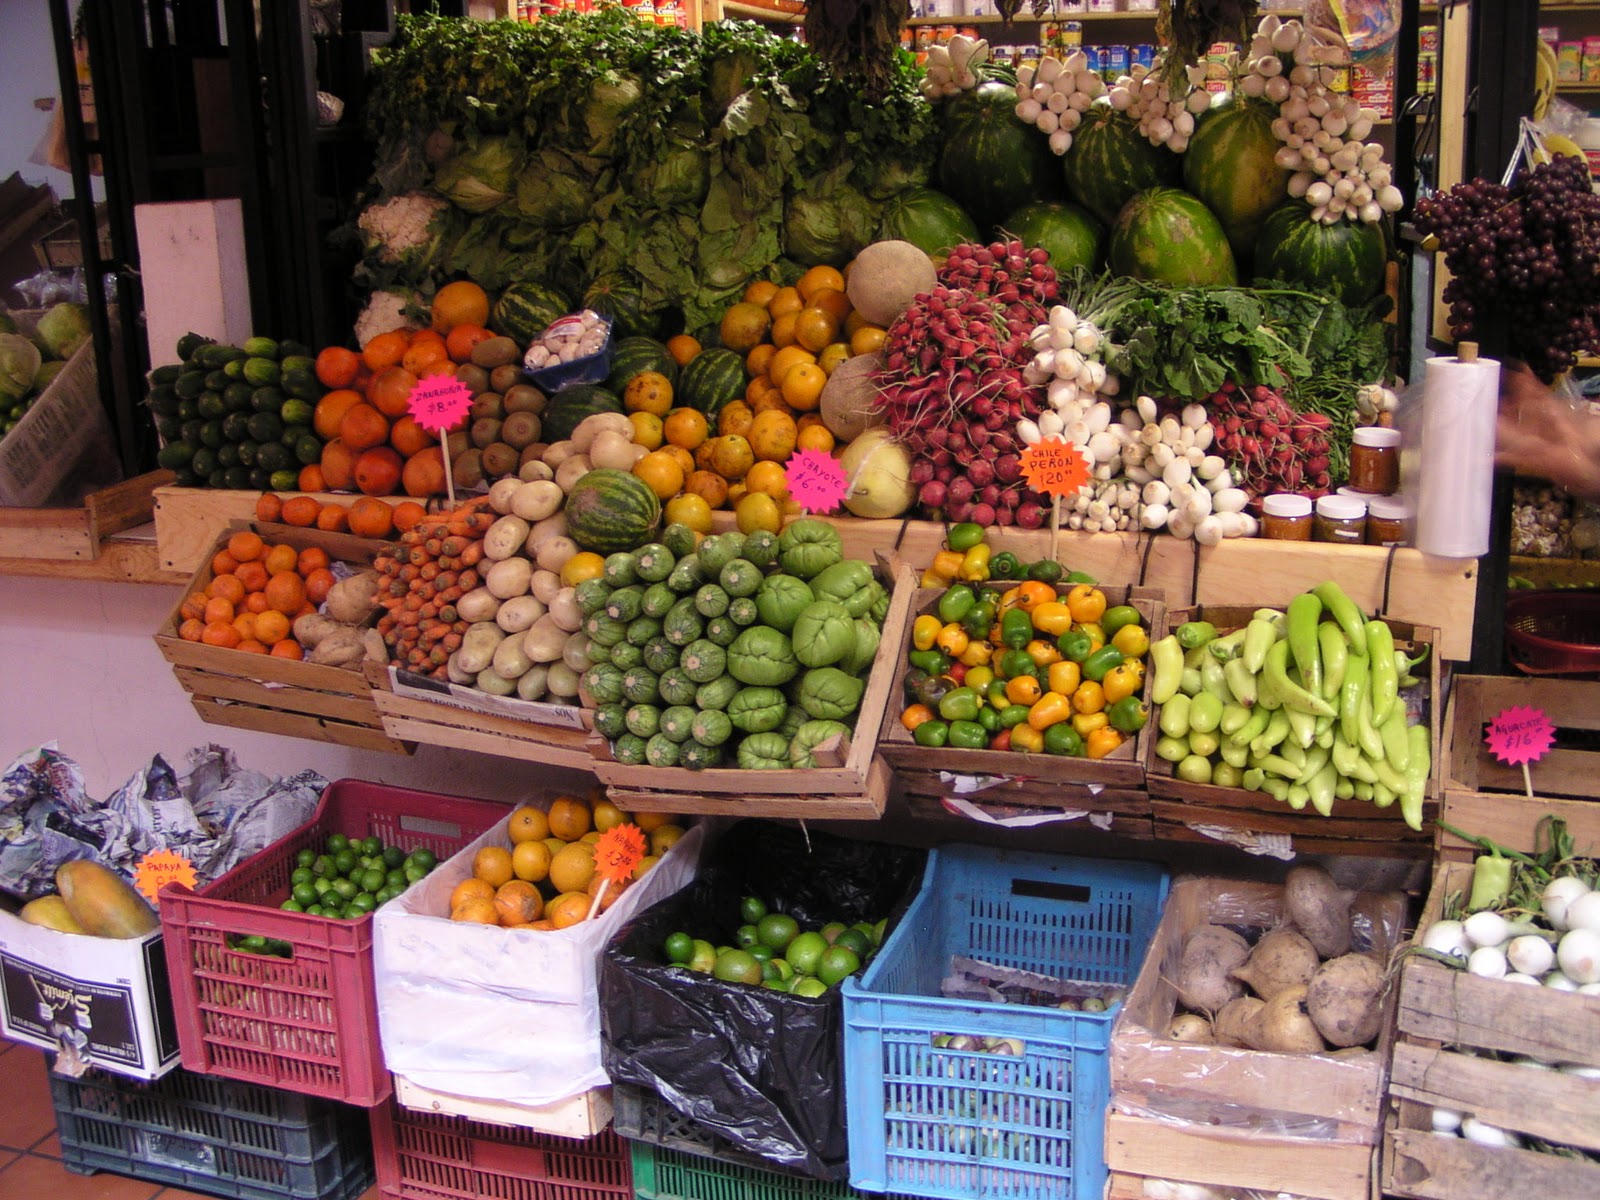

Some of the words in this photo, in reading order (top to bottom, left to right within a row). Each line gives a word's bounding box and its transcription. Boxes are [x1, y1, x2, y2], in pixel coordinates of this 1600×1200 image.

[1032, 449, 1061, 458] CHILE
[1029, 456, 1073, 472] PERON
[802, 457, 842, 489] CHAYOTE
[146, 862, 182, 872] PAPAYA
